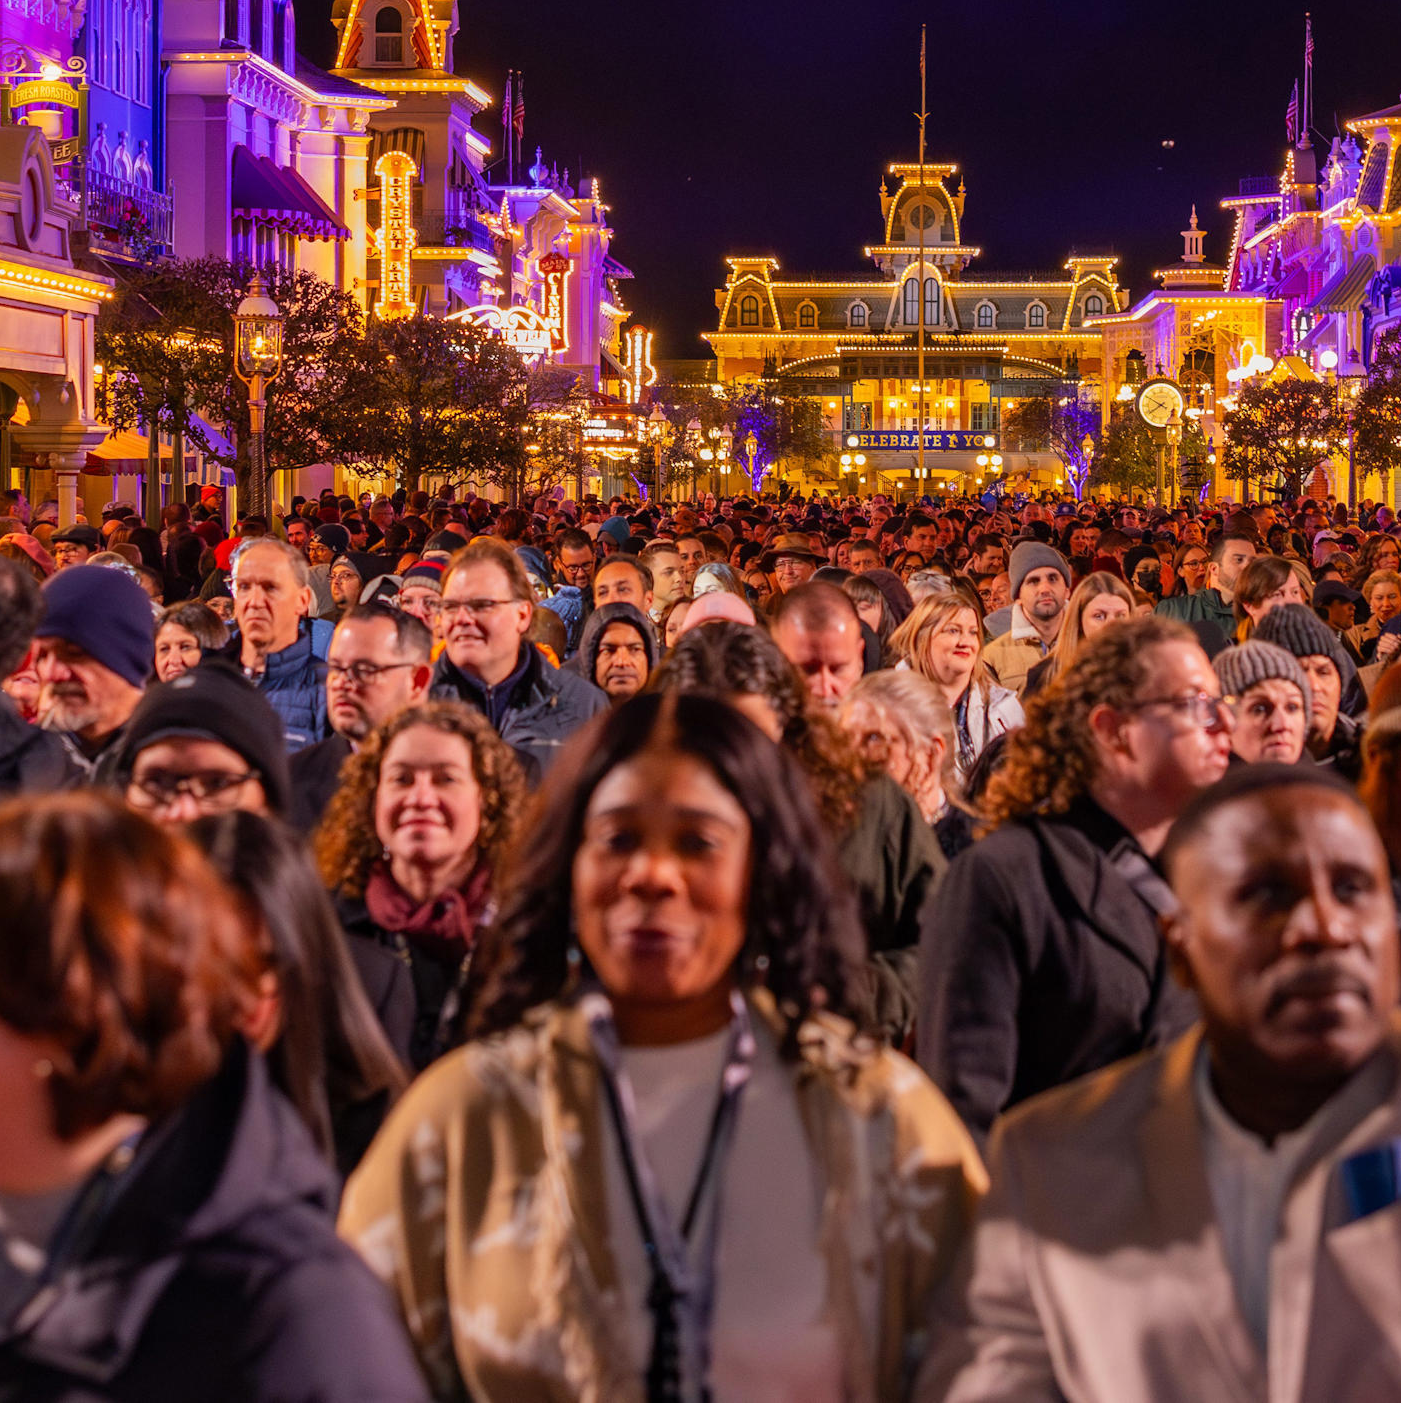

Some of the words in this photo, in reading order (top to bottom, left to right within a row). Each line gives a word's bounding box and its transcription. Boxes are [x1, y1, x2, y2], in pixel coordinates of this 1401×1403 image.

[15, 87, 38, 102] FRESH
[40, 86, 74, 102] ROASTED
[389, 177, 403, 249] CRYSTAL
[388, 261, 403, 302] ARTS
[848, 434, 942, 447] ELEBRATE
[963, 434, 996, 447] YO
